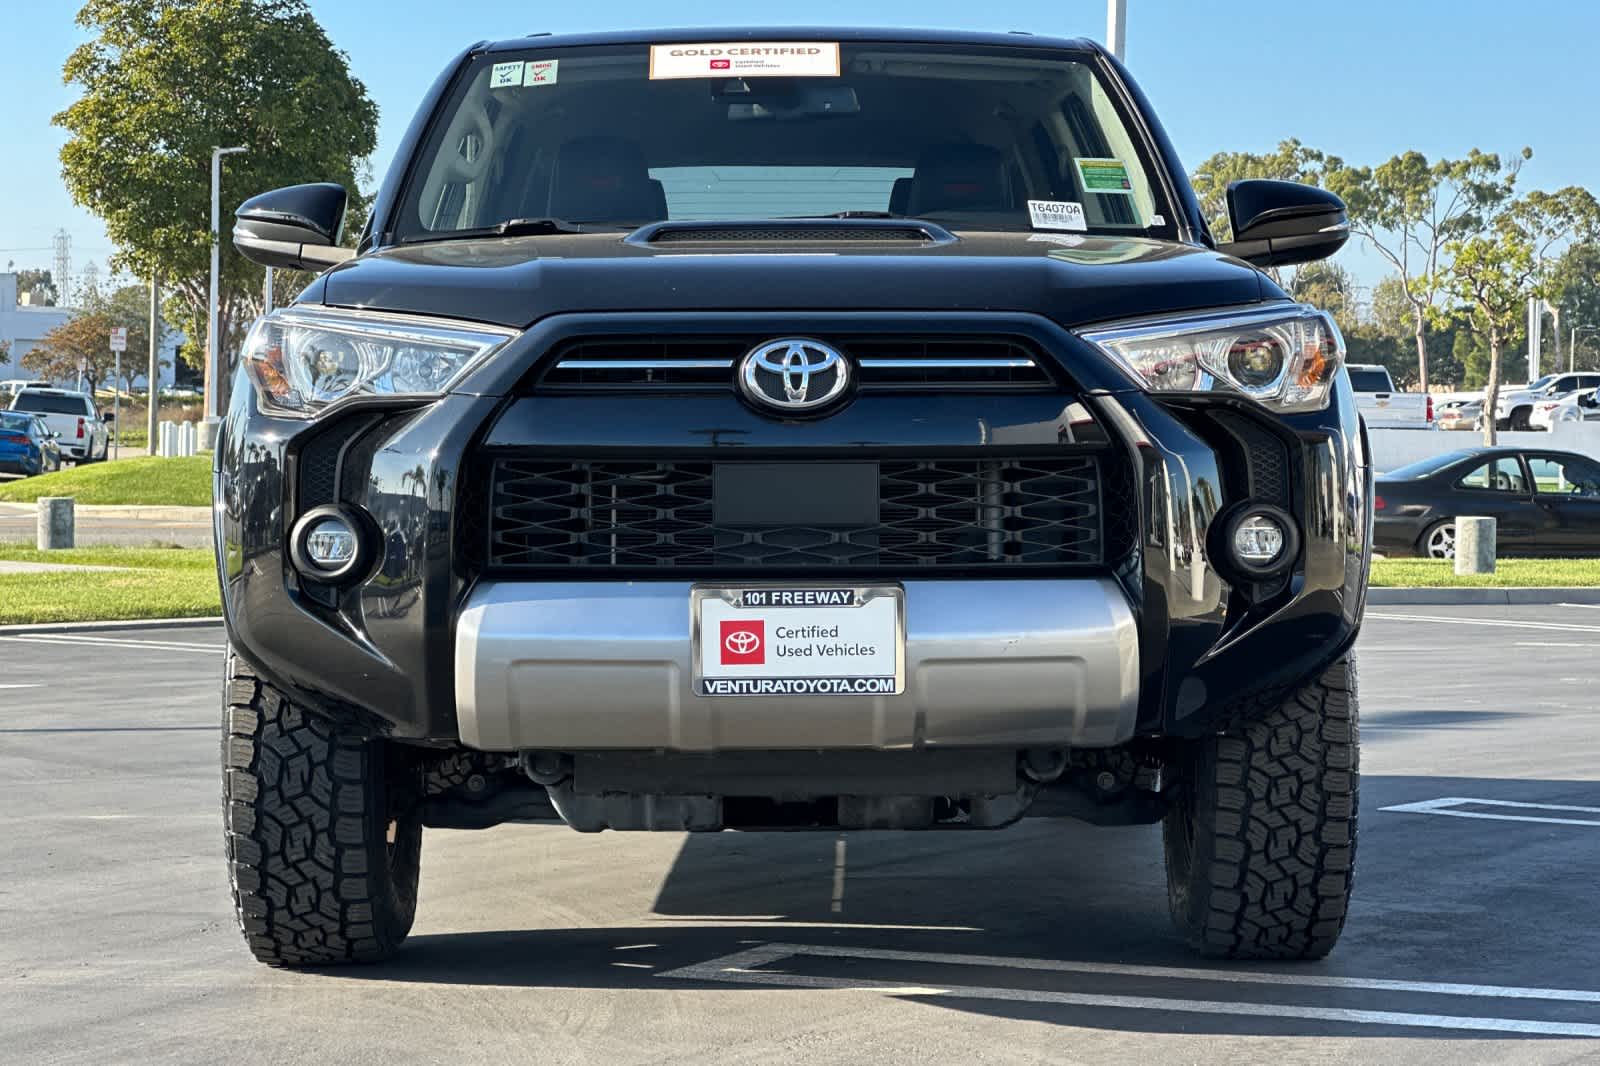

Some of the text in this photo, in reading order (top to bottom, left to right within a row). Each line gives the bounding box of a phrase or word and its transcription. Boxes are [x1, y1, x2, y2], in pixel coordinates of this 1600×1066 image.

[669, 47, 821, 57] GOLD CERTIFIED
[1031, 203, 1081, 214] T64070A
[745, 591, 851, 605] 101 FREEWAY
[775, 626, 839, 639] Certified
[776, 643, 876, 657] Used Vehicles
[704, 678, 894, 694] VENTURATOYOTA.COM
